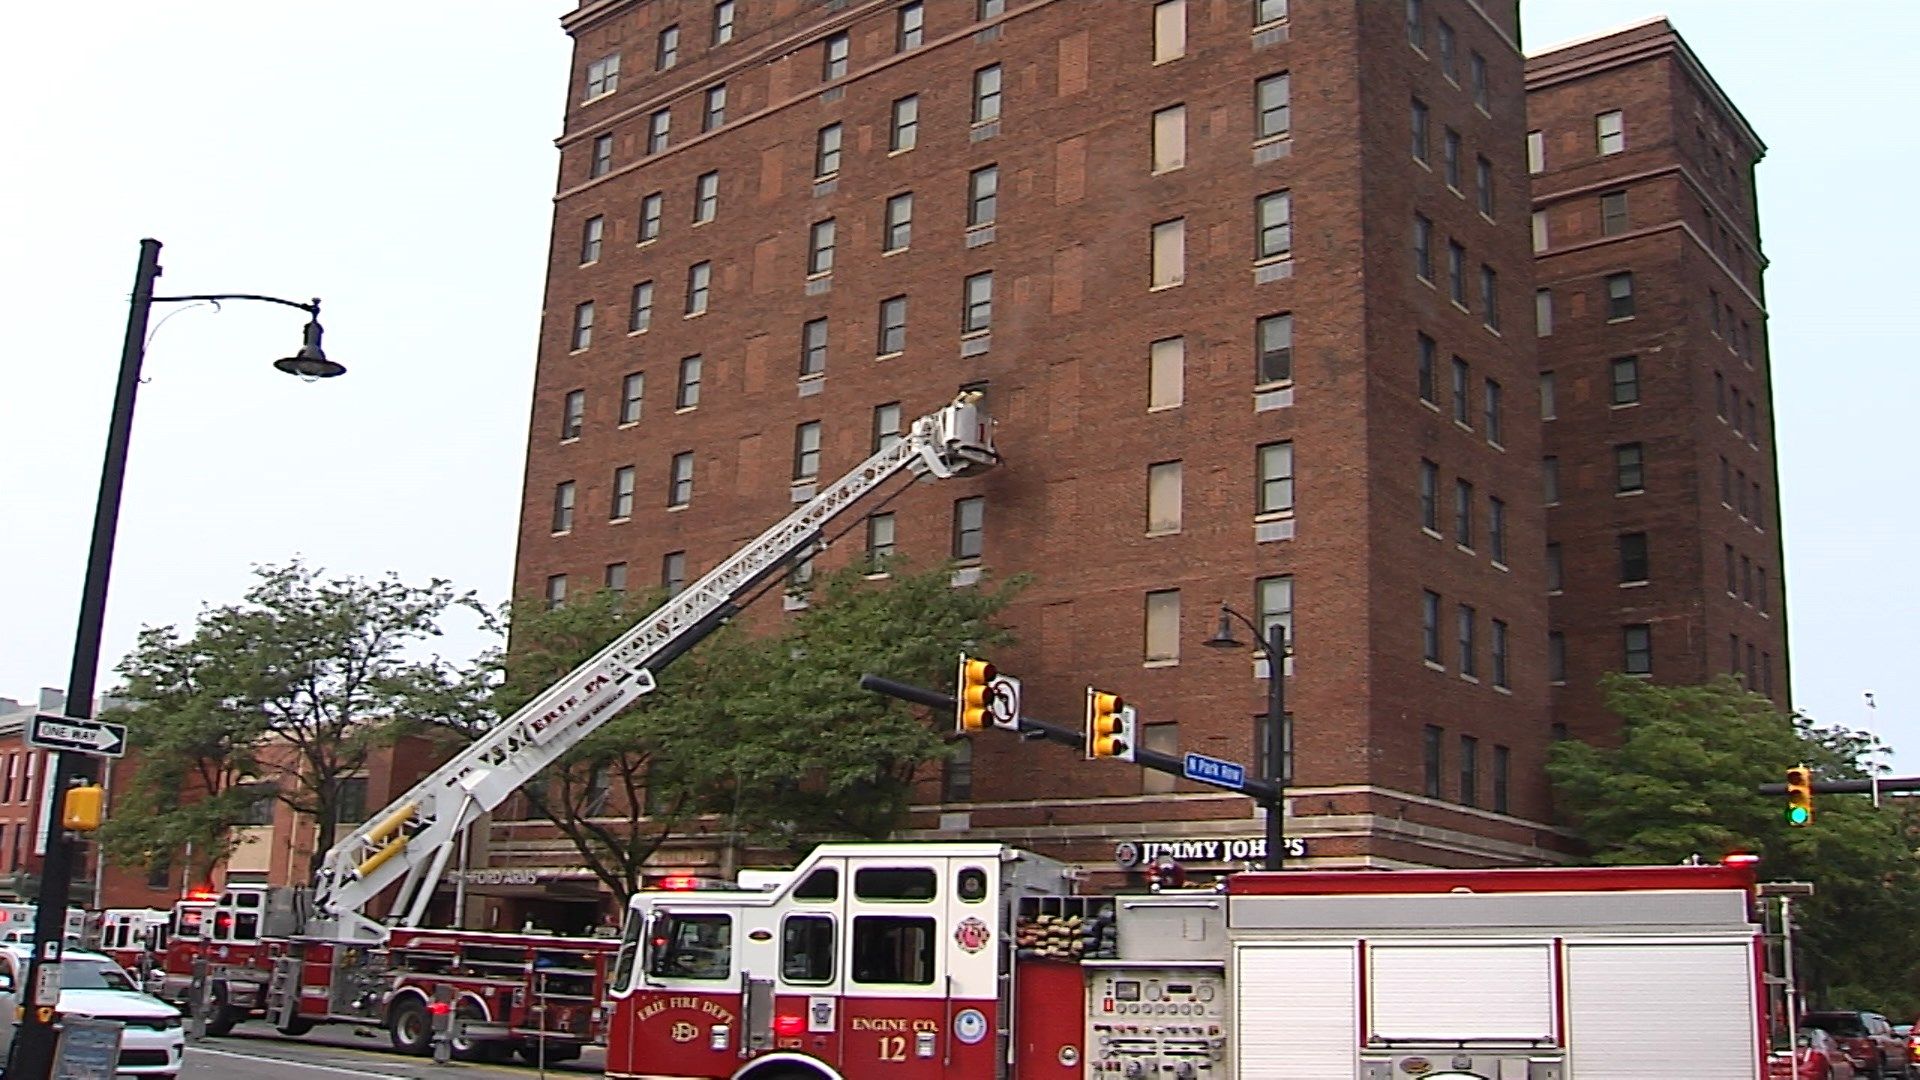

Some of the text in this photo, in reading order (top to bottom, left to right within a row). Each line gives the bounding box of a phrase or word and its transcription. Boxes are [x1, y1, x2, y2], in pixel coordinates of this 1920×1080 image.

[531, 695, 578, 733] ERIE
[584, 675, 610, 694] PA
[42, 725, 98, 741] ONE WAY
[1188, 757, 1240, 782] N Park Row
[1142, 838, 1304, 864] JIMMY JOH'S
[502, 869, 537, 884] ARMS
[636, 1000, 666, 1021] ERIE
[669, 996, 700, 1009] FIRE
[851, 1017, 909, 1032] ENGINE
[878, 1036, 907, 1062] 12
